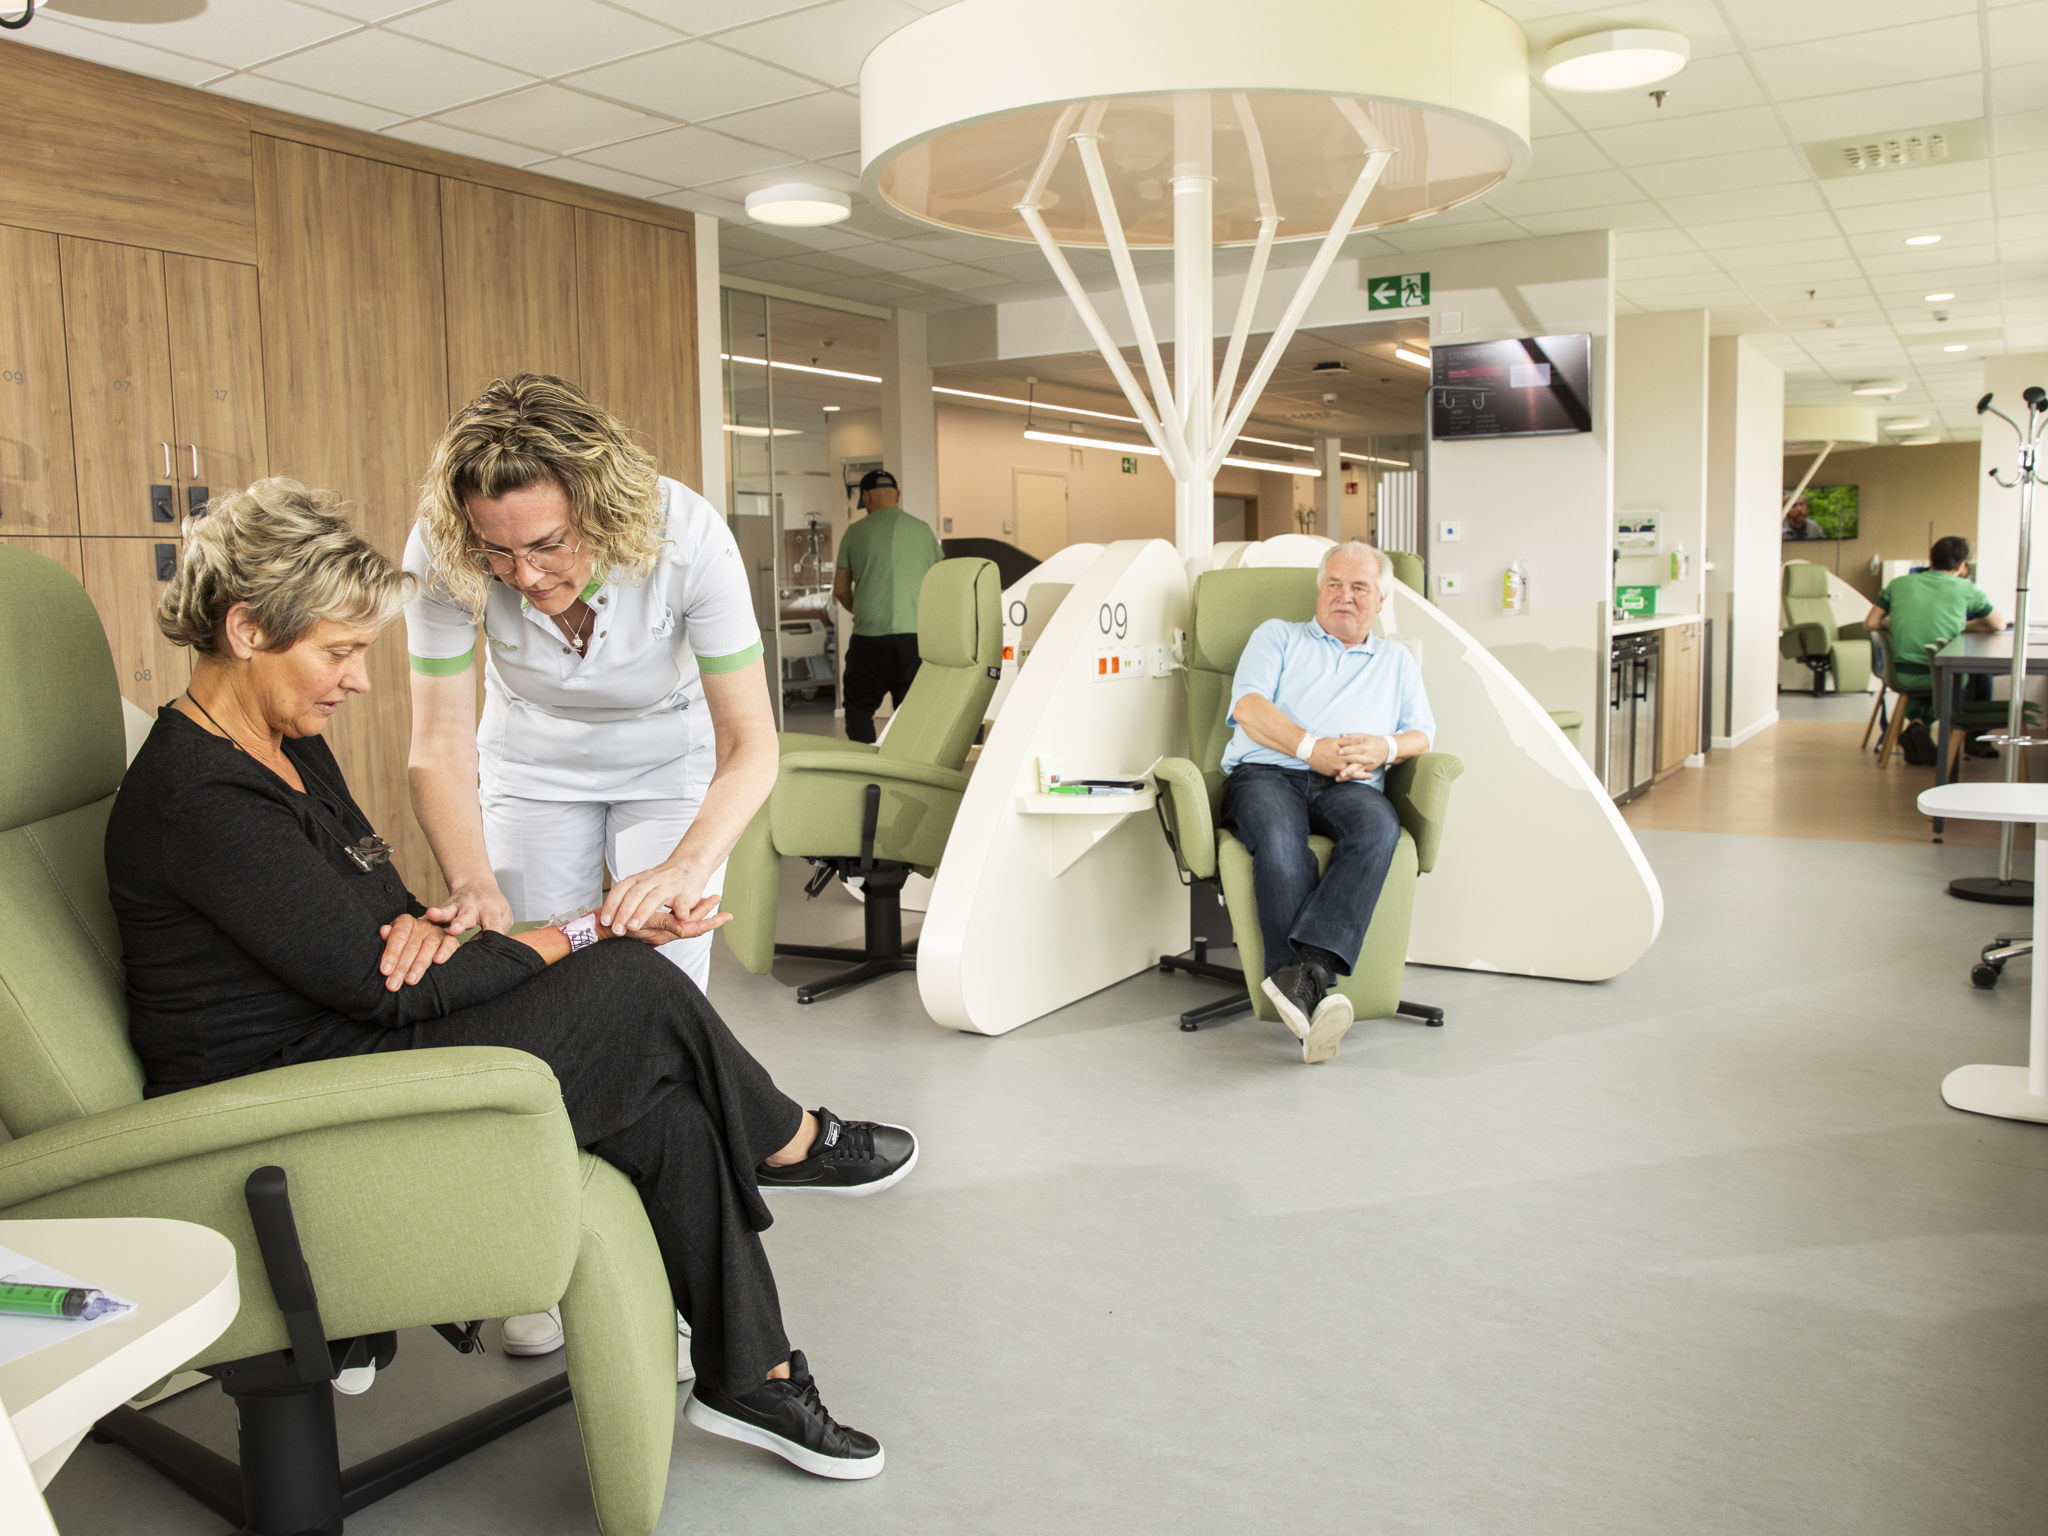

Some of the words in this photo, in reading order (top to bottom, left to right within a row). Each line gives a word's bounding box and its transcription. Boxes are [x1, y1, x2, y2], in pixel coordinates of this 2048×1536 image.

[3, 370, 24, 384] 09
[113, 380, 132, 392] 07
[214, 389, 228, 401] 17
[1003, 600, 1028, 627] 0
[1099, 602, 1128, 640] 09
[134, 669, 152, 681] 08
